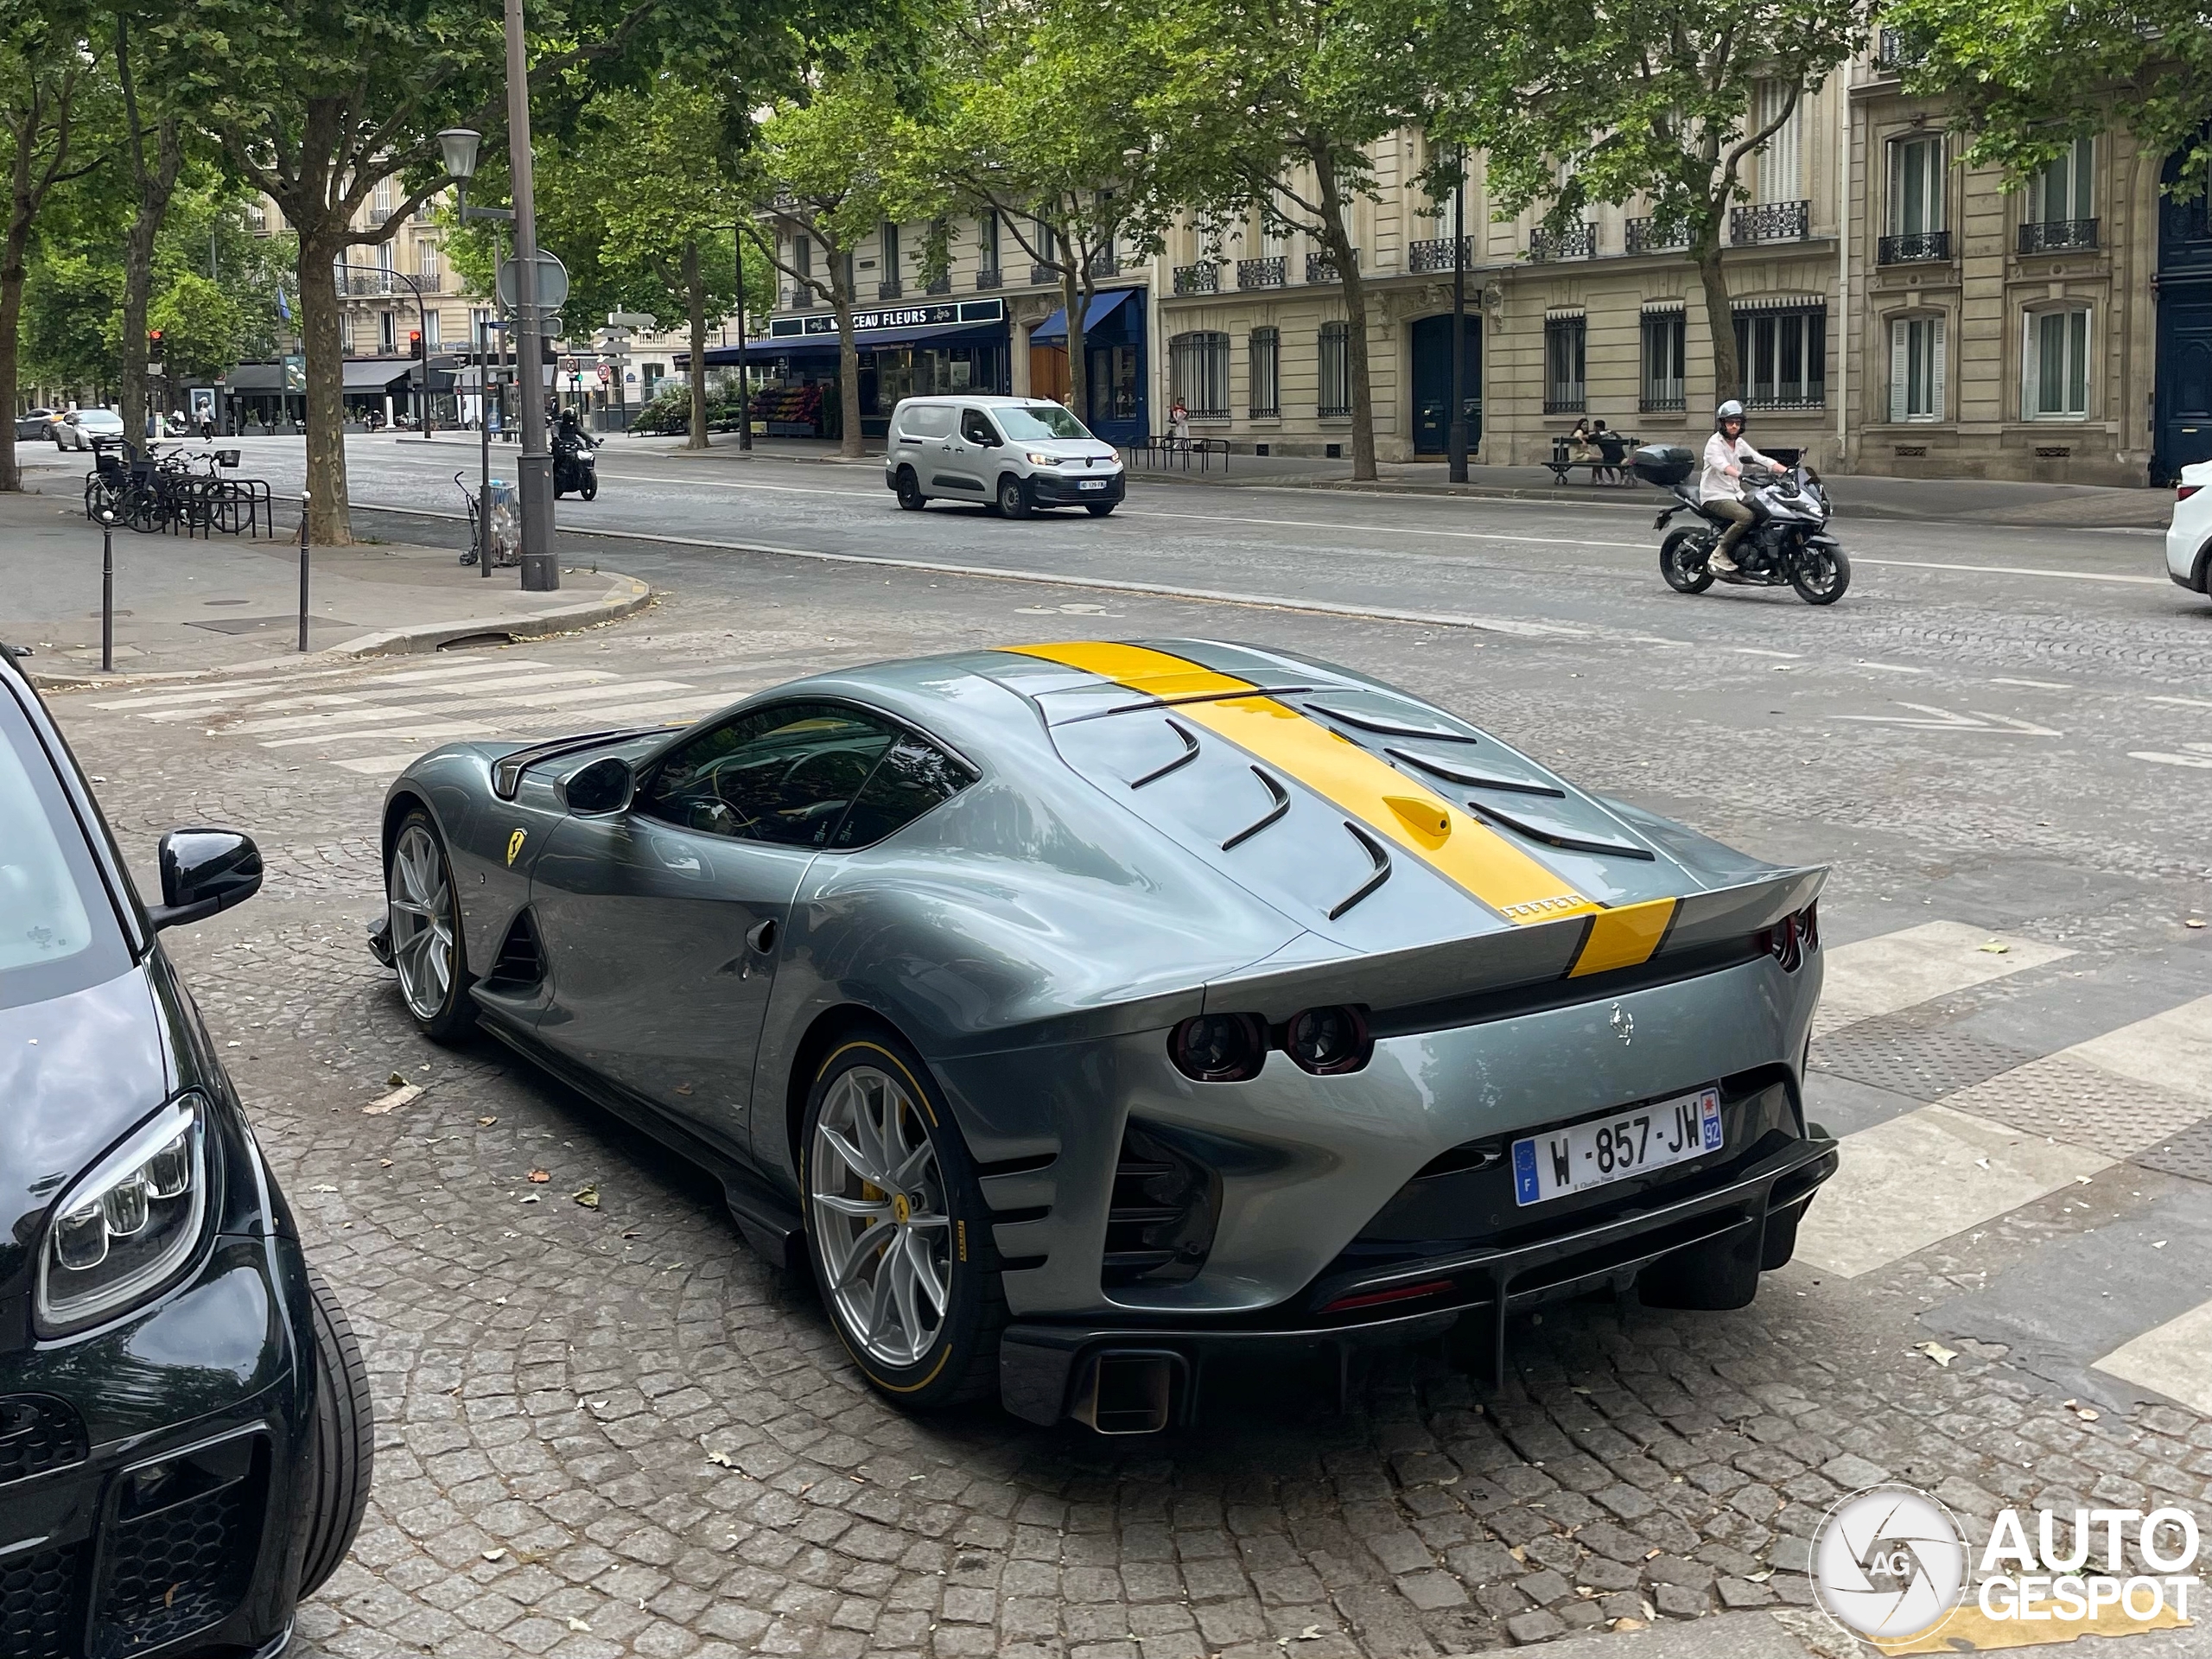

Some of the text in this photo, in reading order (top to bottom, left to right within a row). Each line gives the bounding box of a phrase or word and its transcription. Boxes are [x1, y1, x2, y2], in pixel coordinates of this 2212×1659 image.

[830, 311, 926, 330] MCEAU FLEURS
[1499, 895, 1590, 918] Ferrari
[1524, 1178, 1532, 1192] F
[1705, 1121, 1720, 1144] 92
